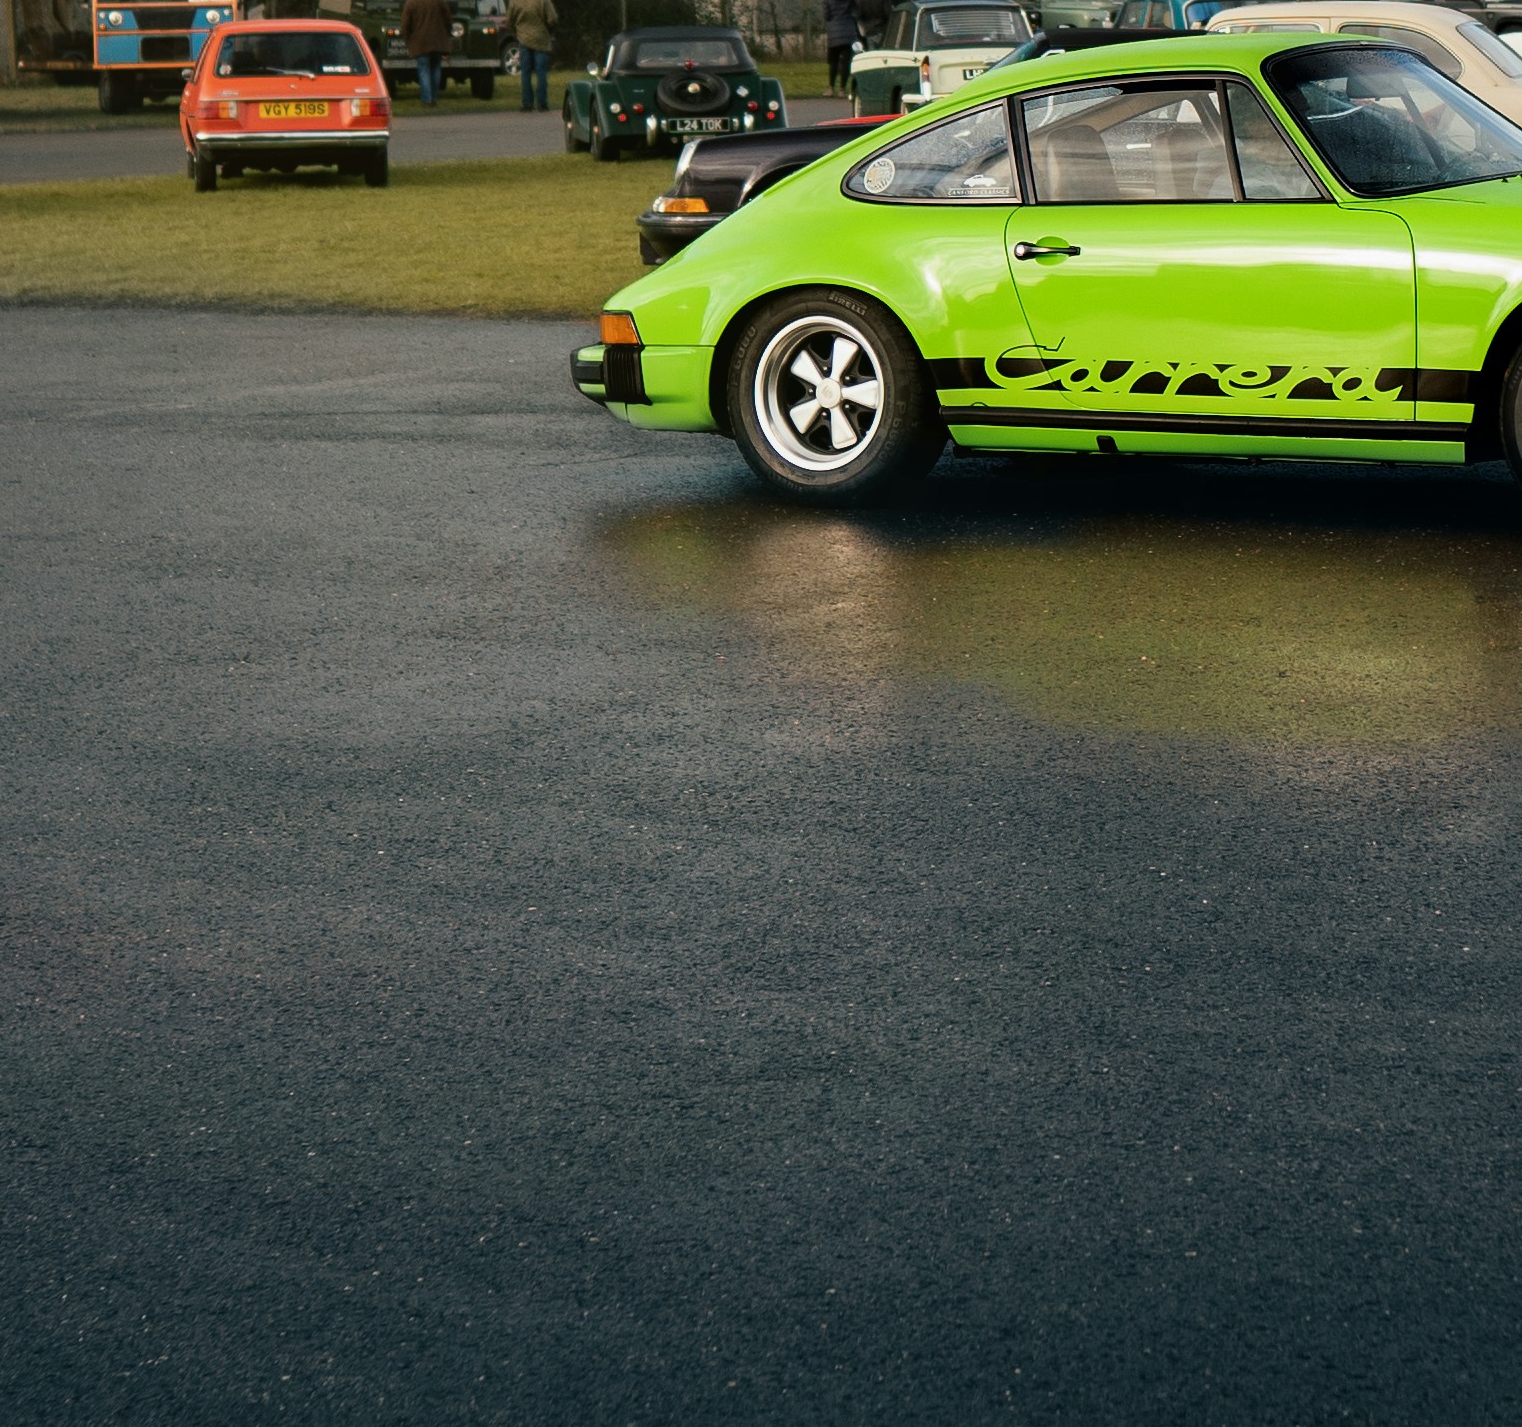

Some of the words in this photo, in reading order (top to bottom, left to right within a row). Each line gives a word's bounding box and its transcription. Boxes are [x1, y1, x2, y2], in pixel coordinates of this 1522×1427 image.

[264, 104, 289, 116] VGY
[294, 103, 326, 115] 519S
[677, 119, 698, 131] L24
[984, 336, 1404, 403] Carrera
